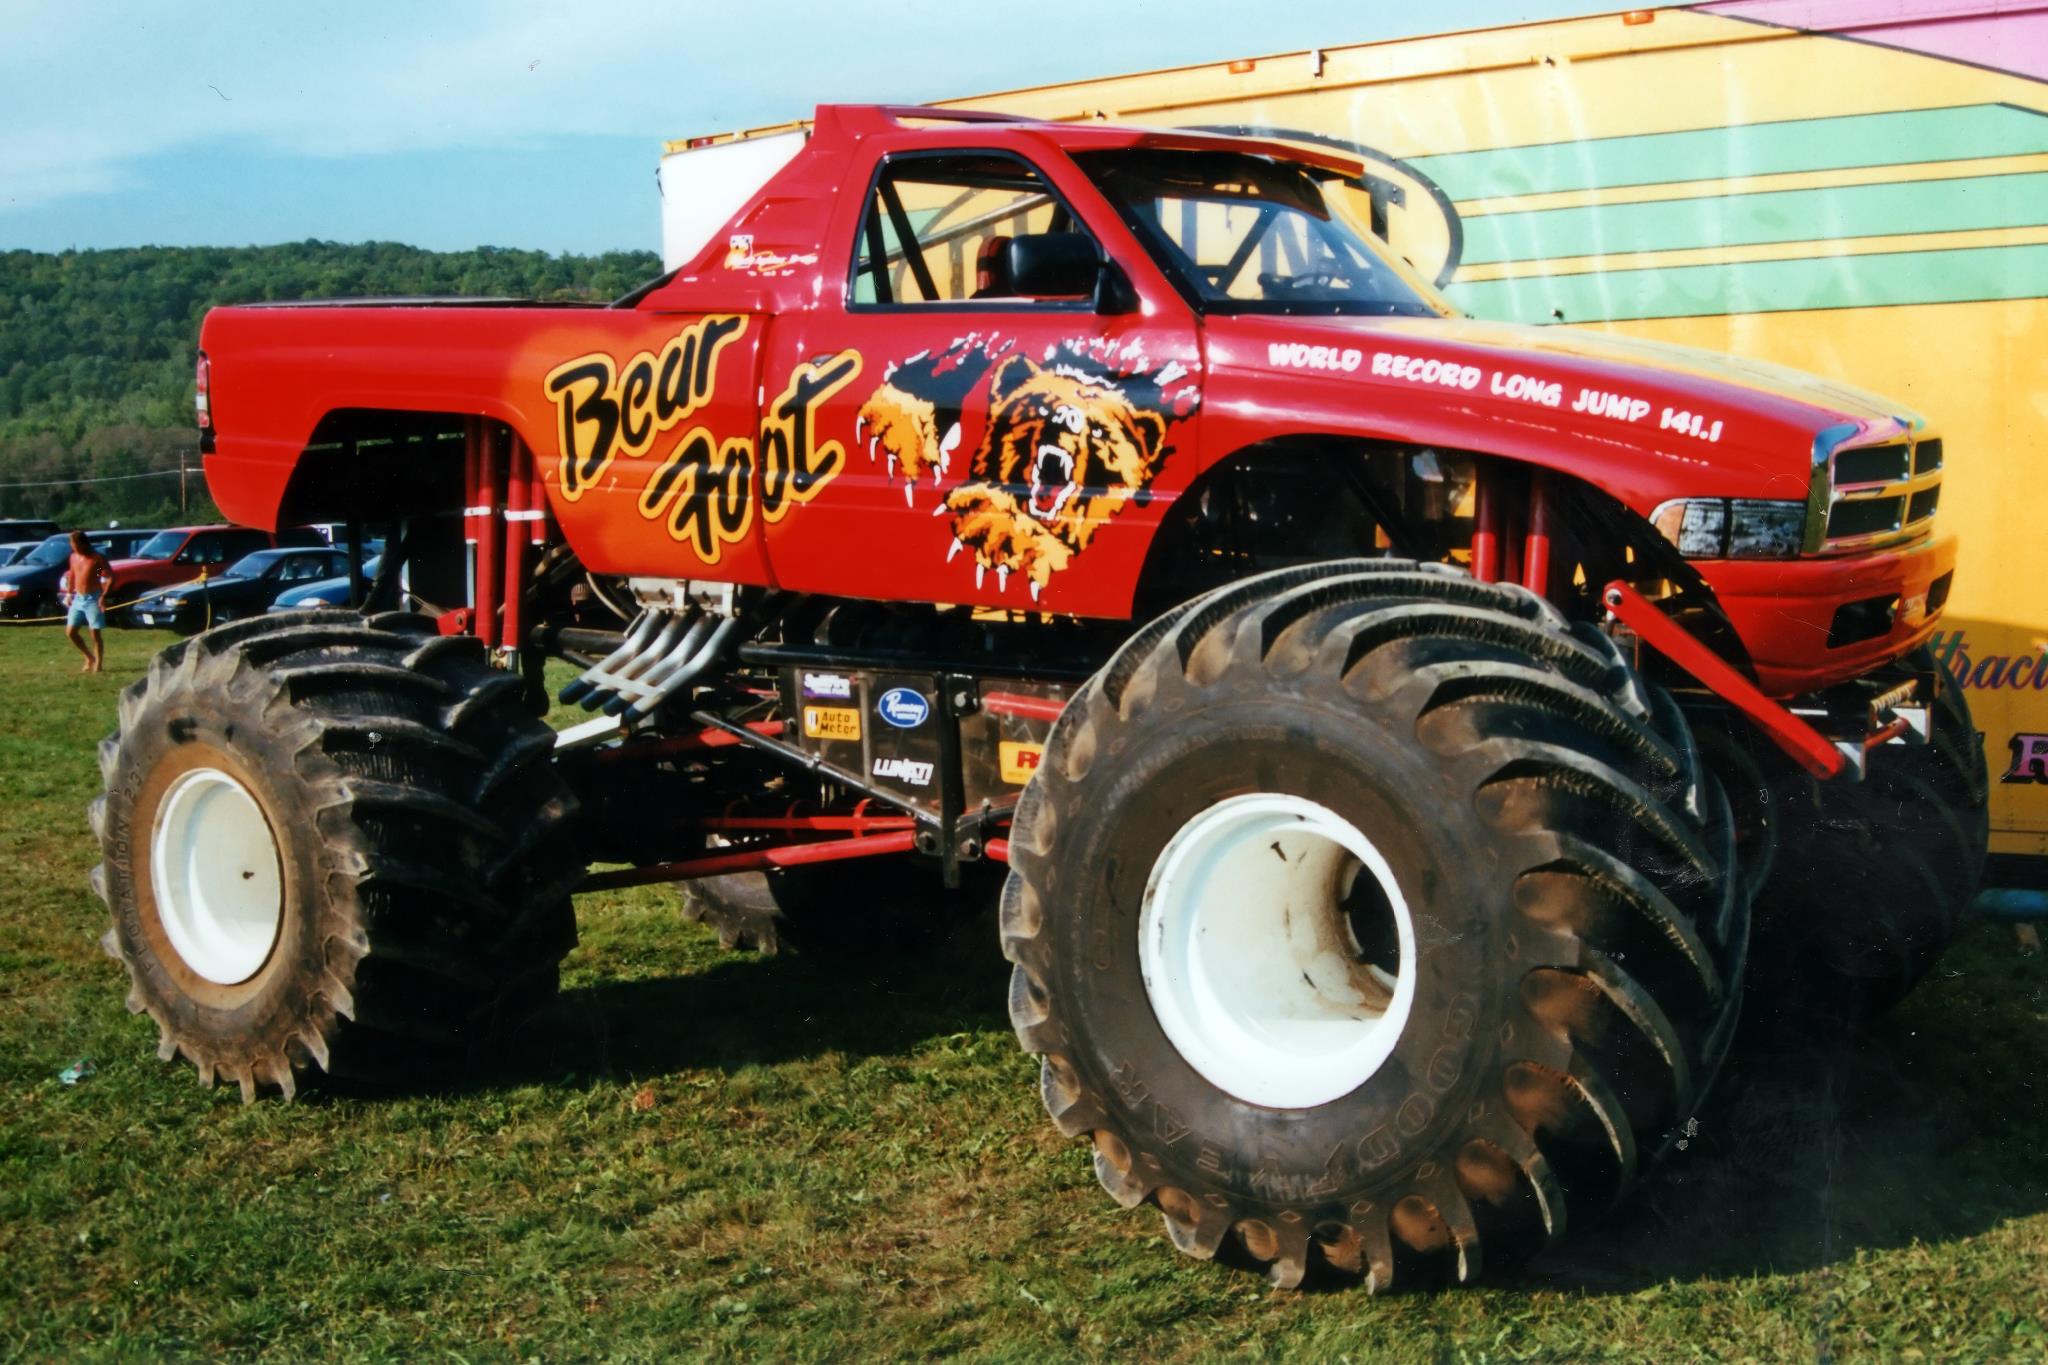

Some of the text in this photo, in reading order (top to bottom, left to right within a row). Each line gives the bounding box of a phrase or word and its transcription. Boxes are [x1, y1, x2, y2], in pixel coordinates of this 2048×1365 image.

[543, 314, 750, 502] Bear
[1267, 342, 1724, 443] WORLD RECORD LONG JUMP 141.1
[819, 722, 857, 735] Meter
[821, 711, 851, 723] Auto
